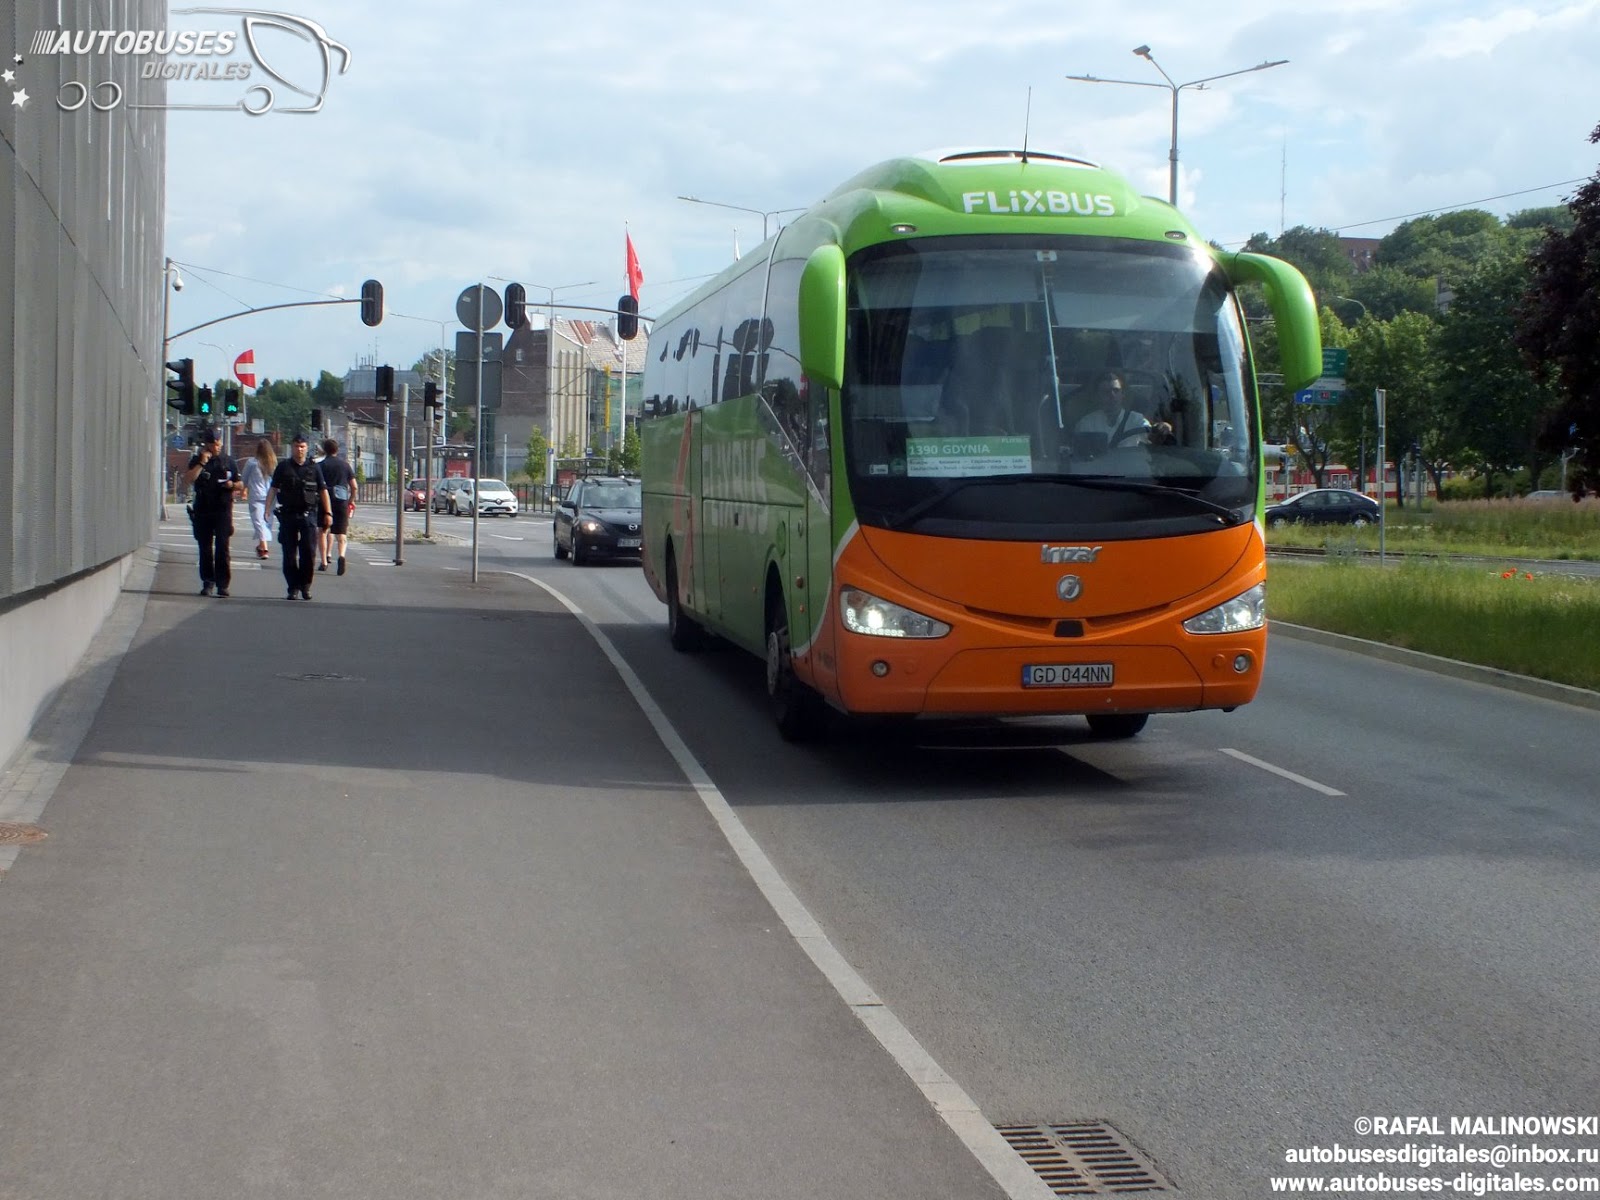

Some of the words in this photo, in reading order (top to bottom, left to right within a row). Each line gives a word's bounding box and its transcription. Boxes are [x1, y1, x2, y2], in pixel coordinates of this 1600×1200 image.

[908, 445, 938, 455] 1390
[942, 444, 991, 455] GDYNIA
[1033, 667, 1056, 683] GD
[1062, 666, 1110, 683] 044NN
